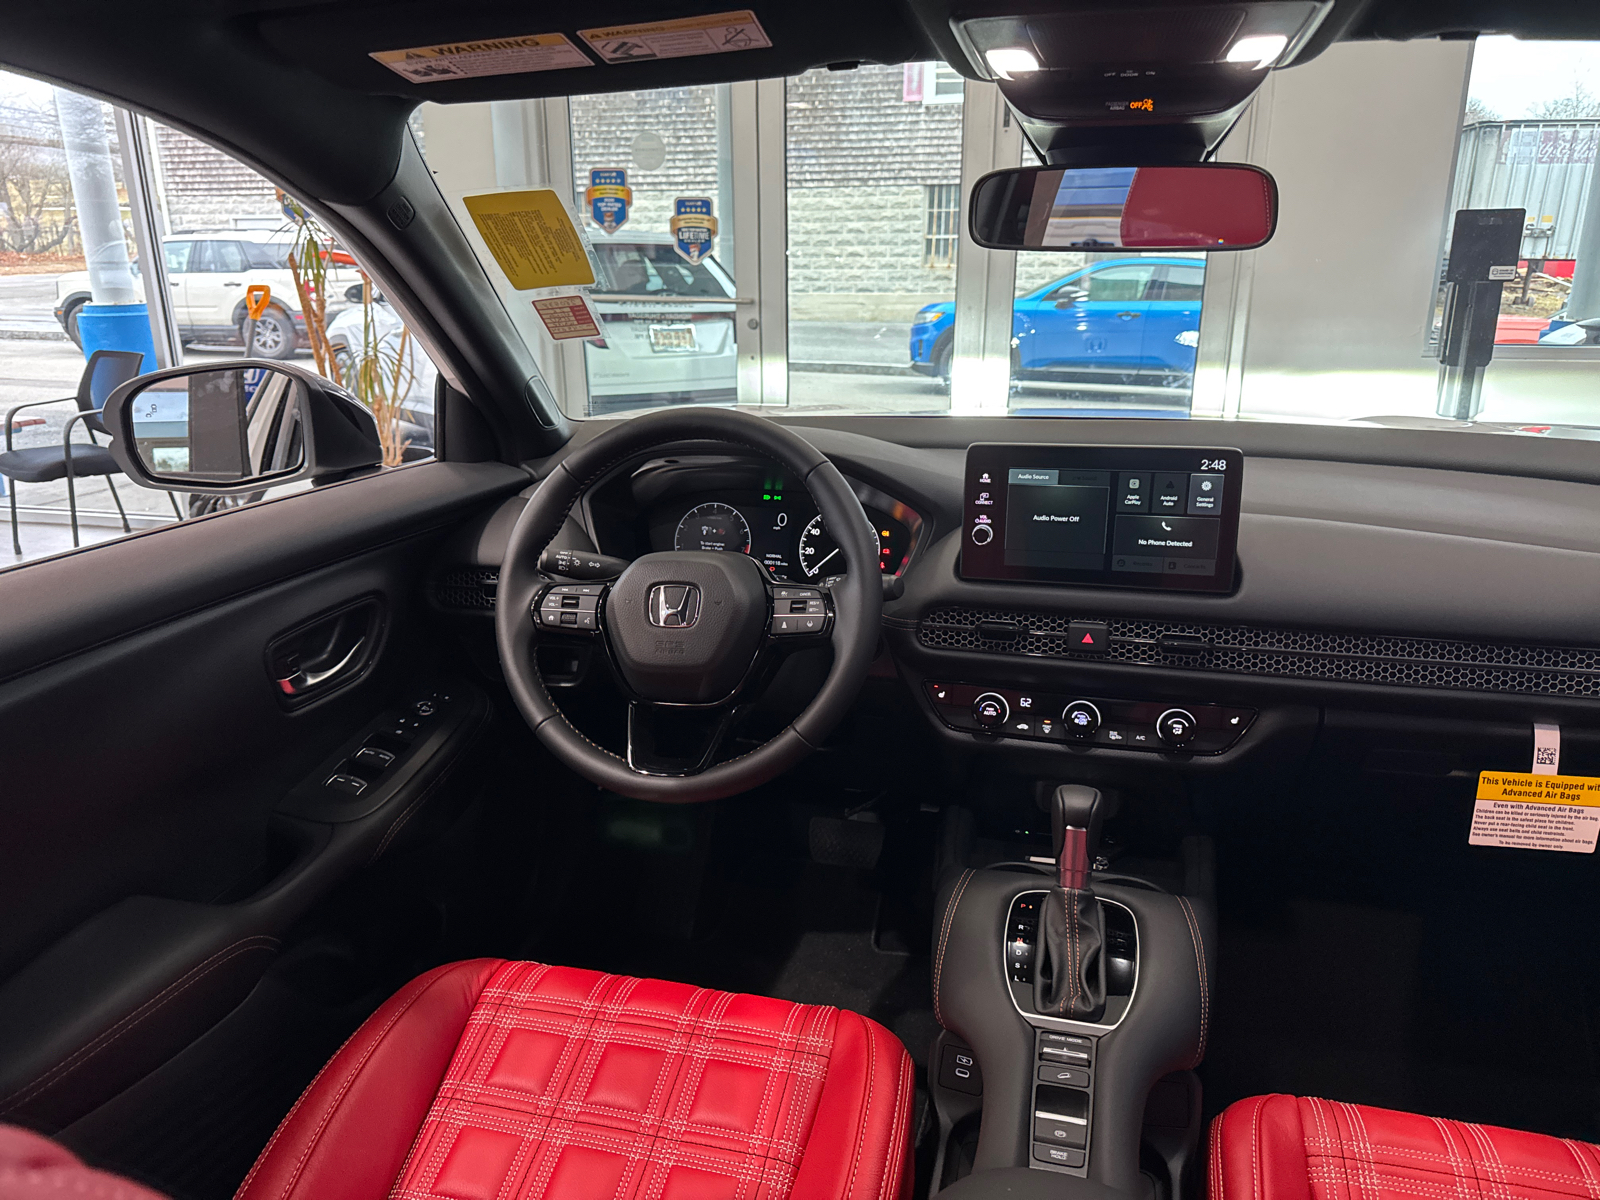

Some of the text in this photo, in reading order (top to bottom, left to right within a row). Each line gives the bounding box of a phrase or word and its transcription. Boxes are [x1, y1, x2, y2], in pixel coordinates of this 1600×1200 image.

[431, 38, 540, 56] WARNING
[1200, 459, 1226, 470] 2:48
[777, 513, 788, 527] 0
[1020, 697, 1032, 707] 62
[1482, 777, 1600, 792] This Vehicle is Equipped wit
[1502, 788, 1580, 801] Advanced Air Bags
[1525, 804, 1556, 812] Advanced
